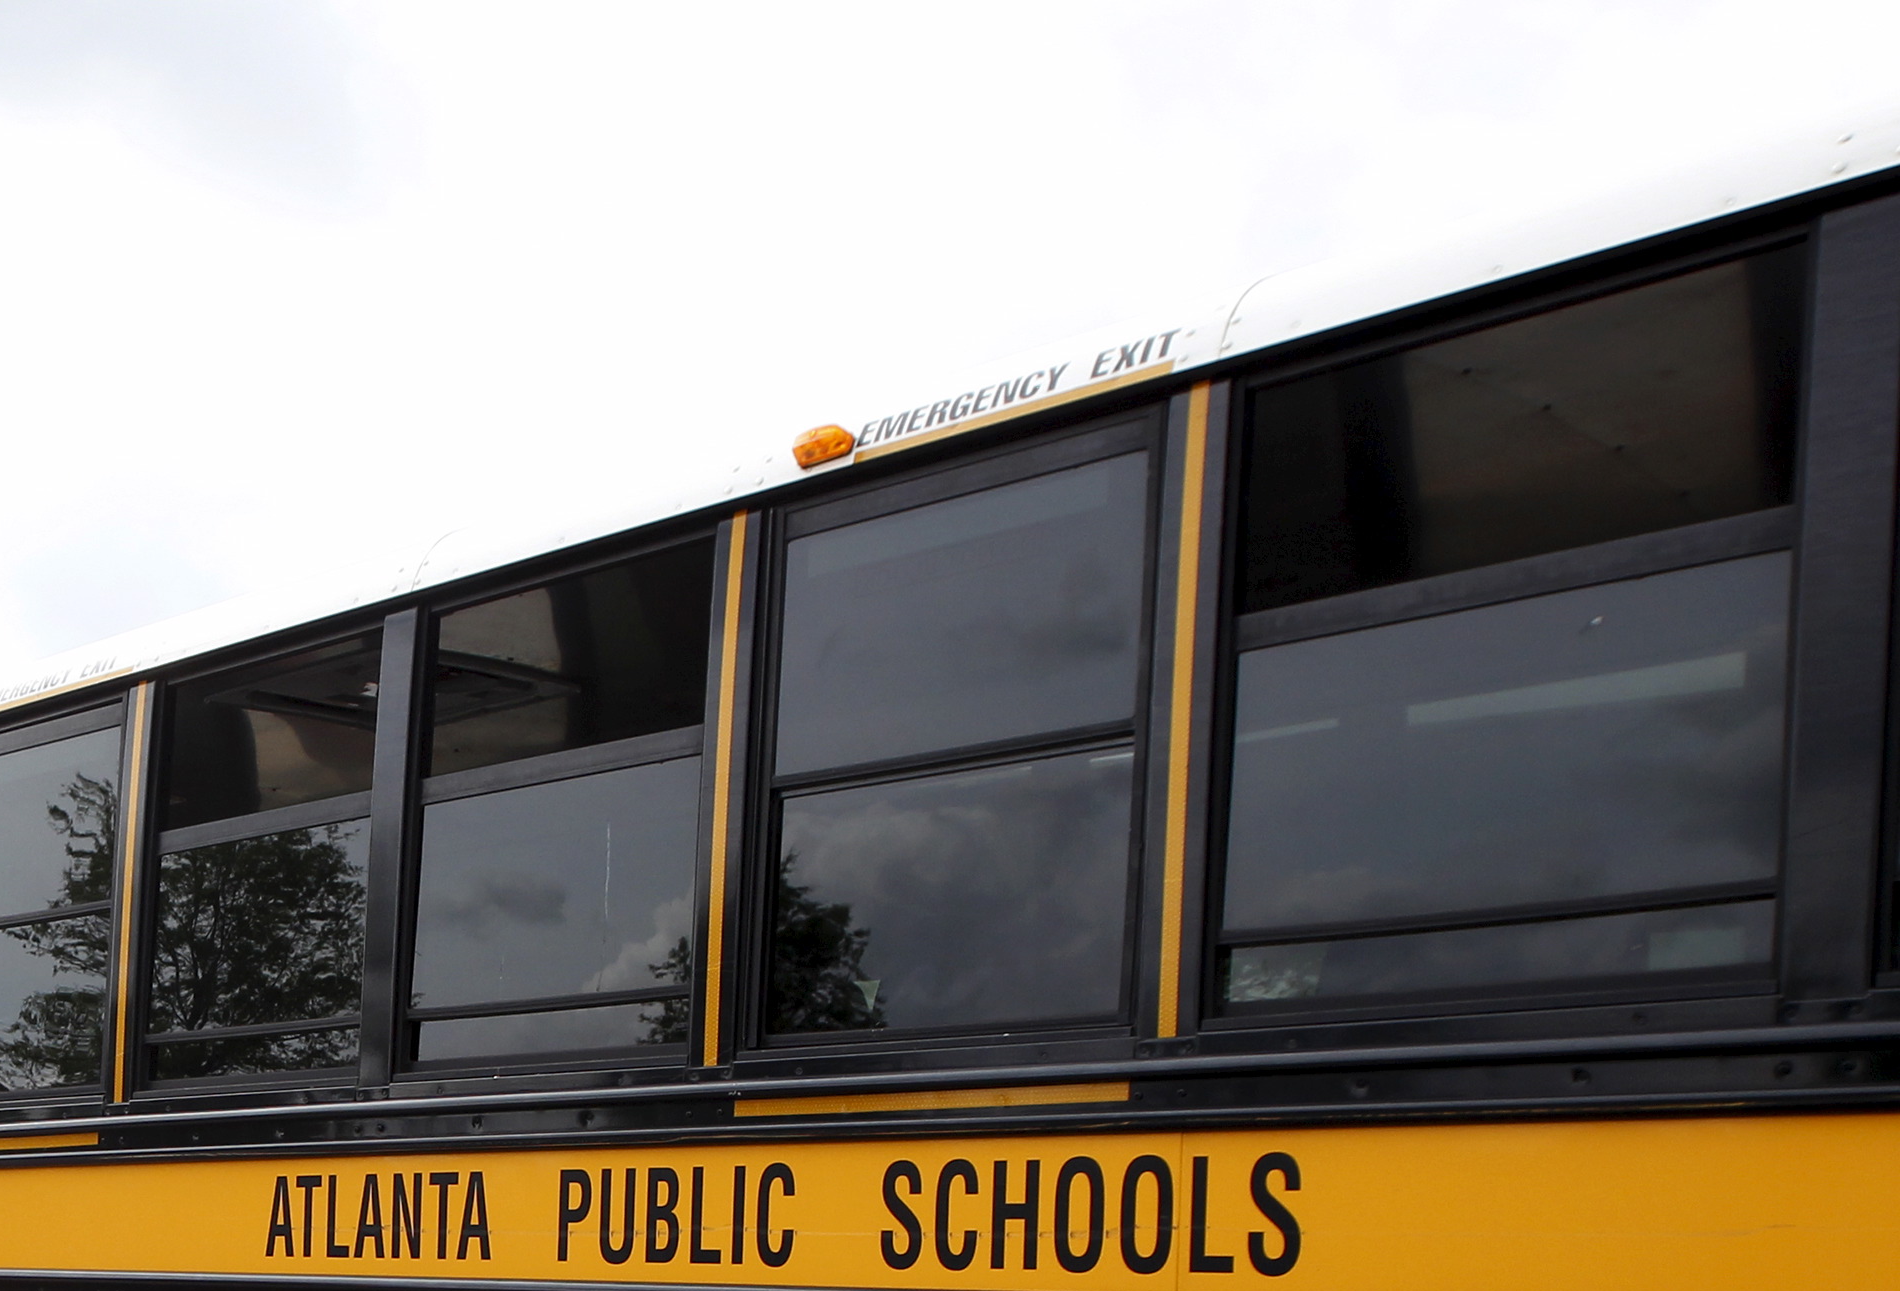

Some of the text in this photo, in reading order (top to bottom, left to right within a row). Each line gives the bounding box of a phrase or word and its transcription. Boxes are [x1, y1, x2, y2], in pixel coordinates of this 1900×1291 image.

[857, 330, 1181, 447] EMERGENCY EXIT
[265, 1151, 1302, 1277] ATLANTA PUBLIC SCHOOLS
